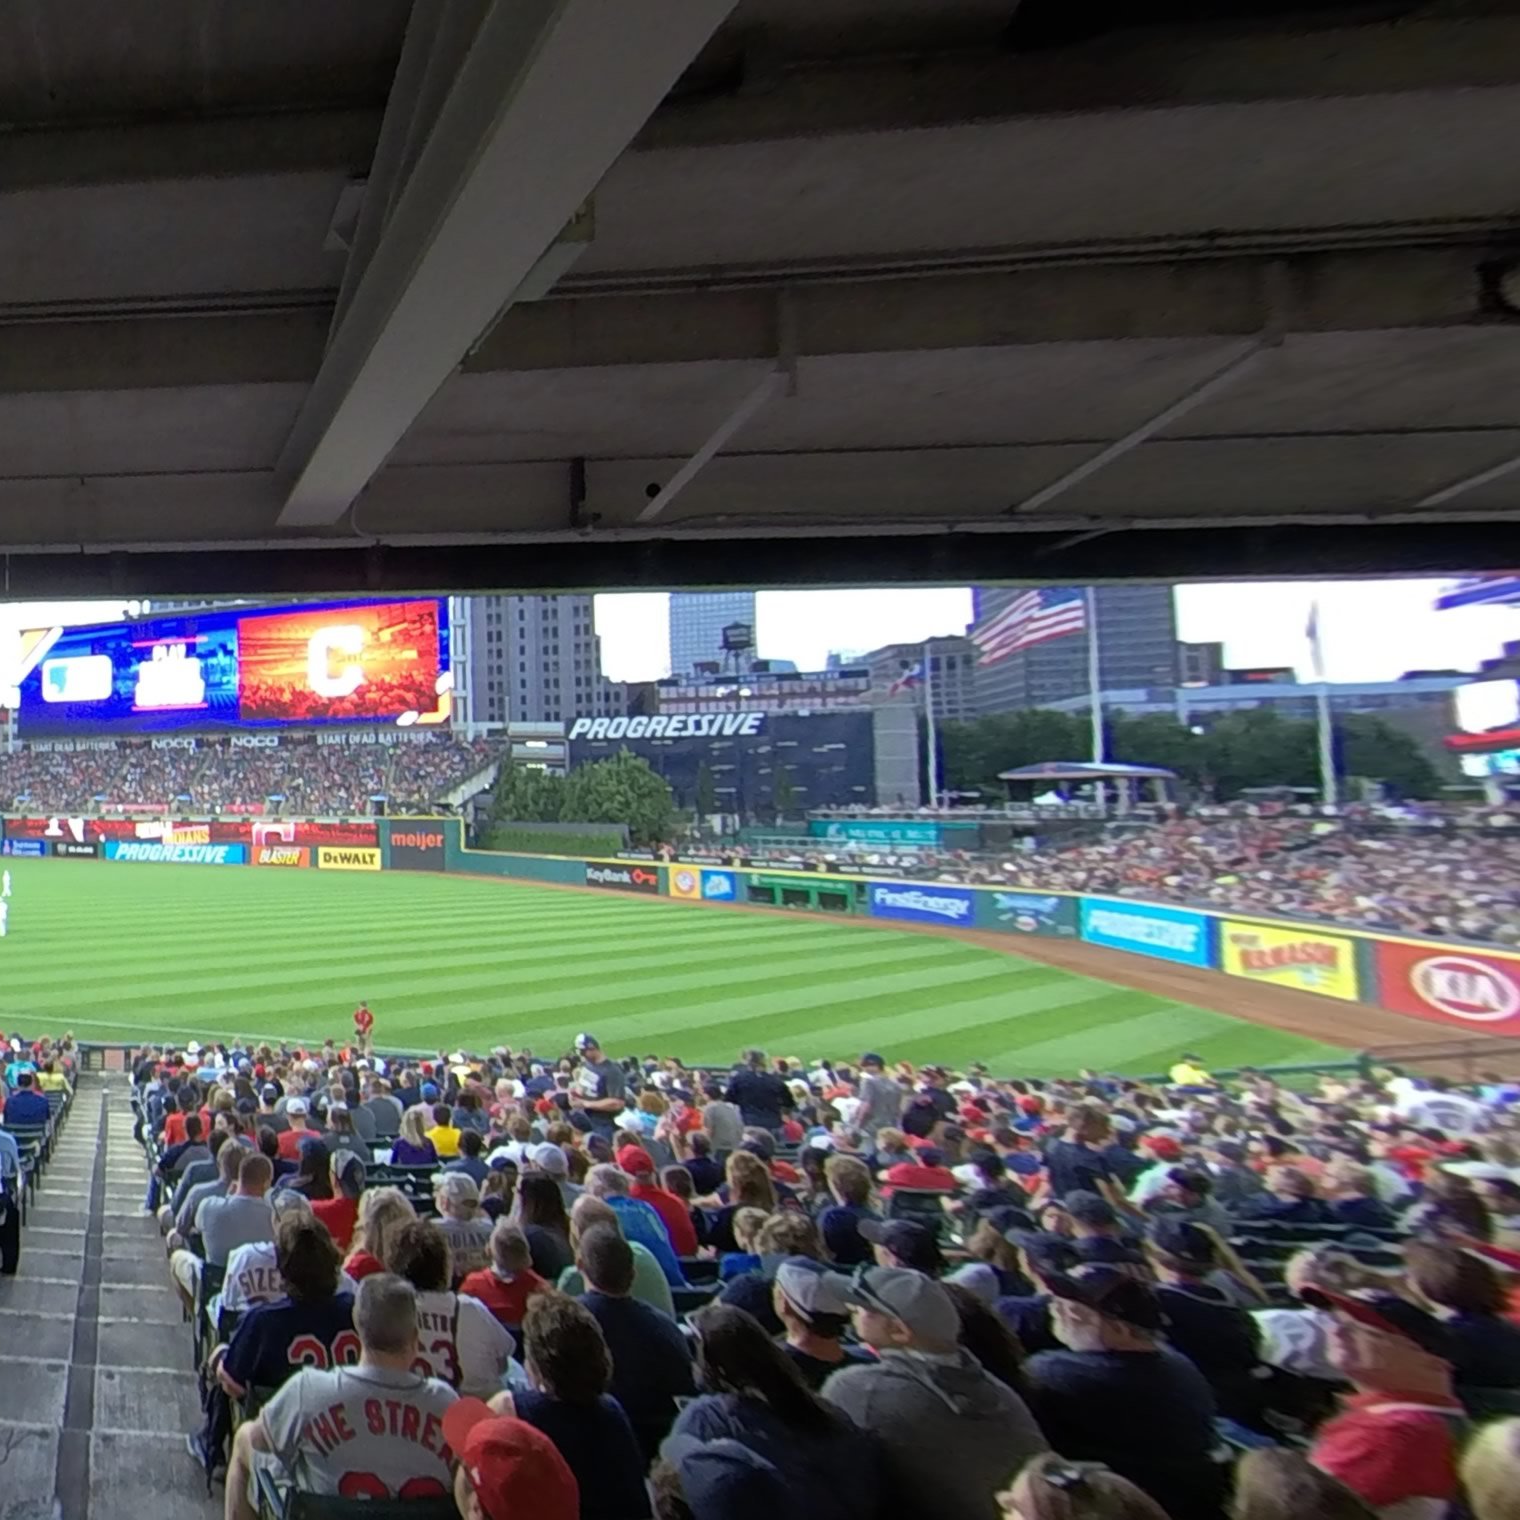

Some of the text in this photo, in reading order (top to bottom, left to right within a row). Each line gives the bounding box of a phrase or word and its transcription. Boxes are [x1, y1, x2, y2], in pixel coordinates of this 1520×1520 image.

[307, 624, 367, 698] C
[568, 713, 765, 739] PROGRESSIVE
[151, 738, 196, 750] NOCO
[231, 736, 279, 748] NOCO
[391, 831, 444, 851] meijer
[114, 842, 229, 863] PROGRESSIVE
[586, 868, 631, 884] KeyBank
[1423, 967, 1507, 1010] KIA
[303, 1402, 356, 1458] THE
